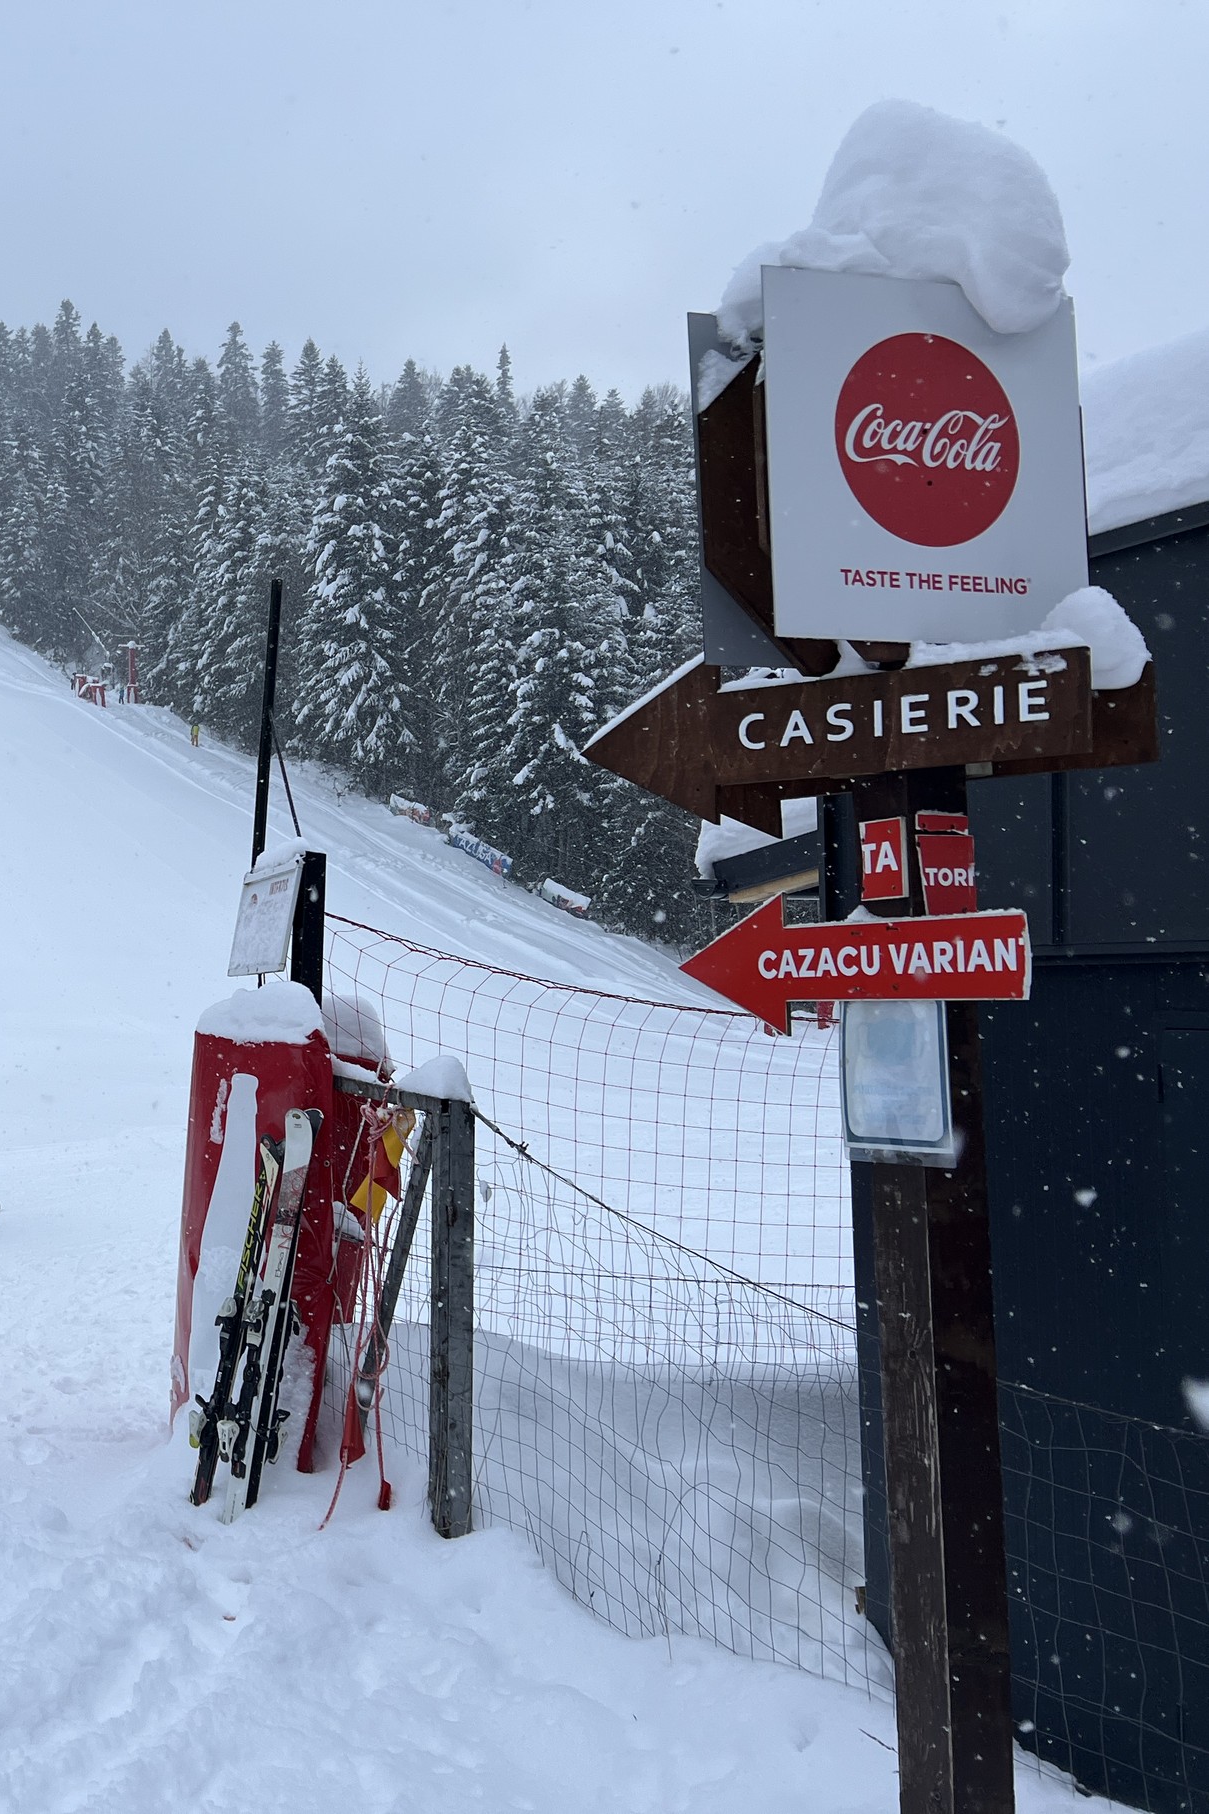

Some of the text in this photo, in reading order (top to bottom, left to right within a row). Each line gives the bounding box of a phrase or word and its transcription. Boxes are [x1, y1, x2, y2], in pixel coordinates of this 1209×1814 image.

[845, 403, 1010, 472] Coca-Cola
[840, 568, 1029, 596] TASTE THE FEELING
[738, 679, 1050, 750] CASIERIE
[922, 865, 975, 887] TORI
[758, 944, 881, 980] CAZACU
[237, 1181, 264, 1289] FISCHER
